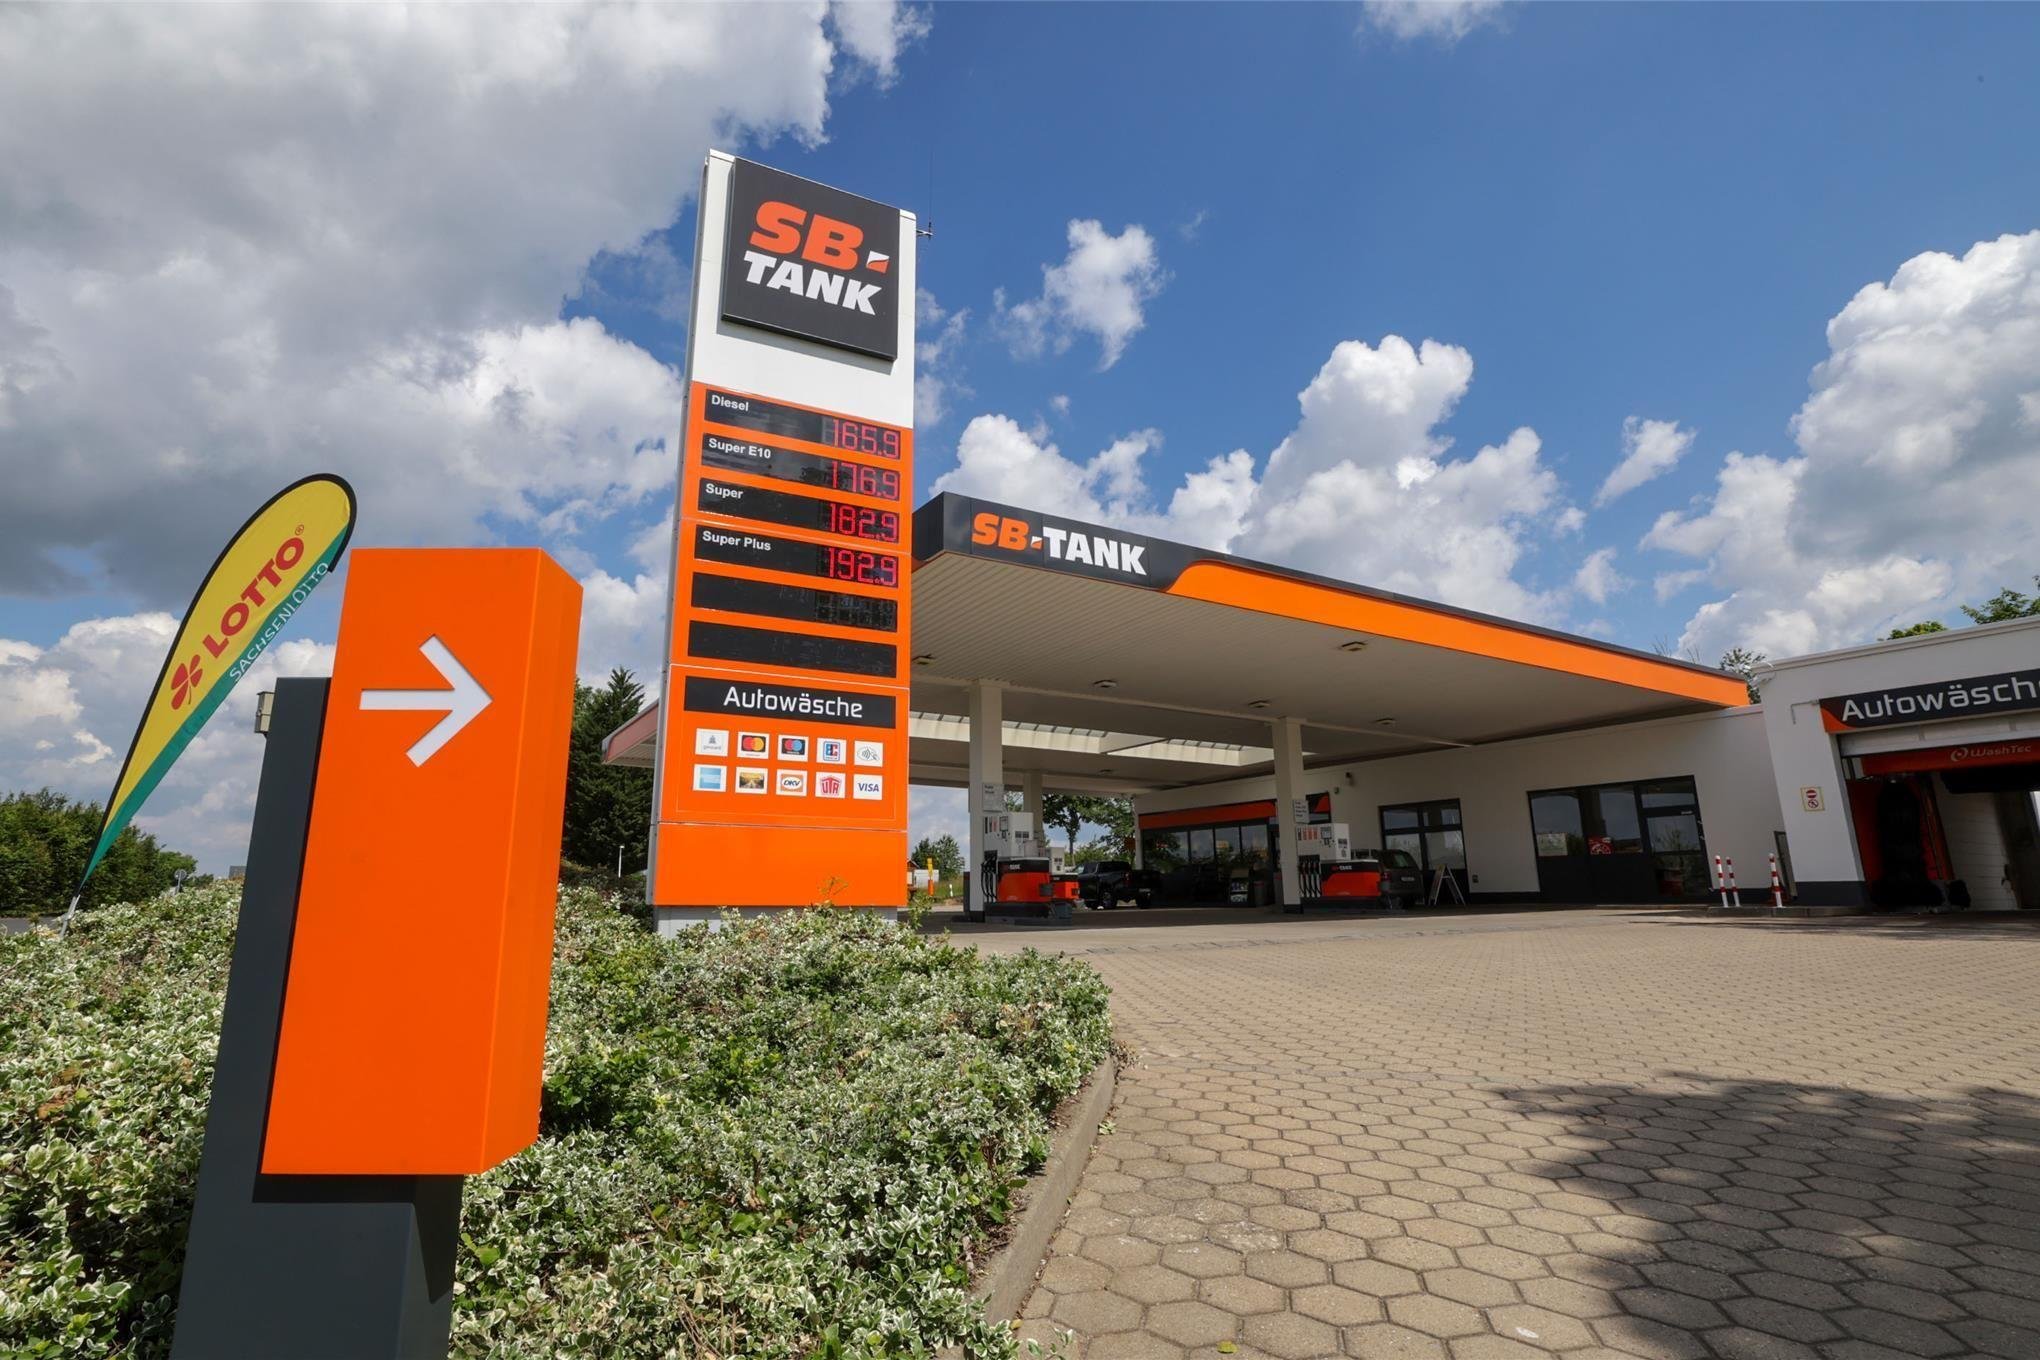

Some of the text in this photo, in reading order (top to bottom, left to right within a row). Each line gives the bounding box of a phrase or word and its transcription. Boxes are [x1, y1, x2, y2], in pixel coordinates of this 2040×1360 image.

[750, 200, 864, 271] SB
[743, 250, 883, 316] TANK
[711, 394, 749, 412] Diesel
[708, 438, 771, 459] Super E10
[705, 483, 743, 500] Super
[702, 530, 771, 551] Super Plus
[1042, 526, 1147, 576] TANK
[202, 536, 305, 659] LOTTO
[723, 686, 863, 718] Autowäsche
[1842, 676, 2040, 722] Autowäsch
[1970, 744, 2032, 757] WashTec
[857, 782, 880, 792] VISA
